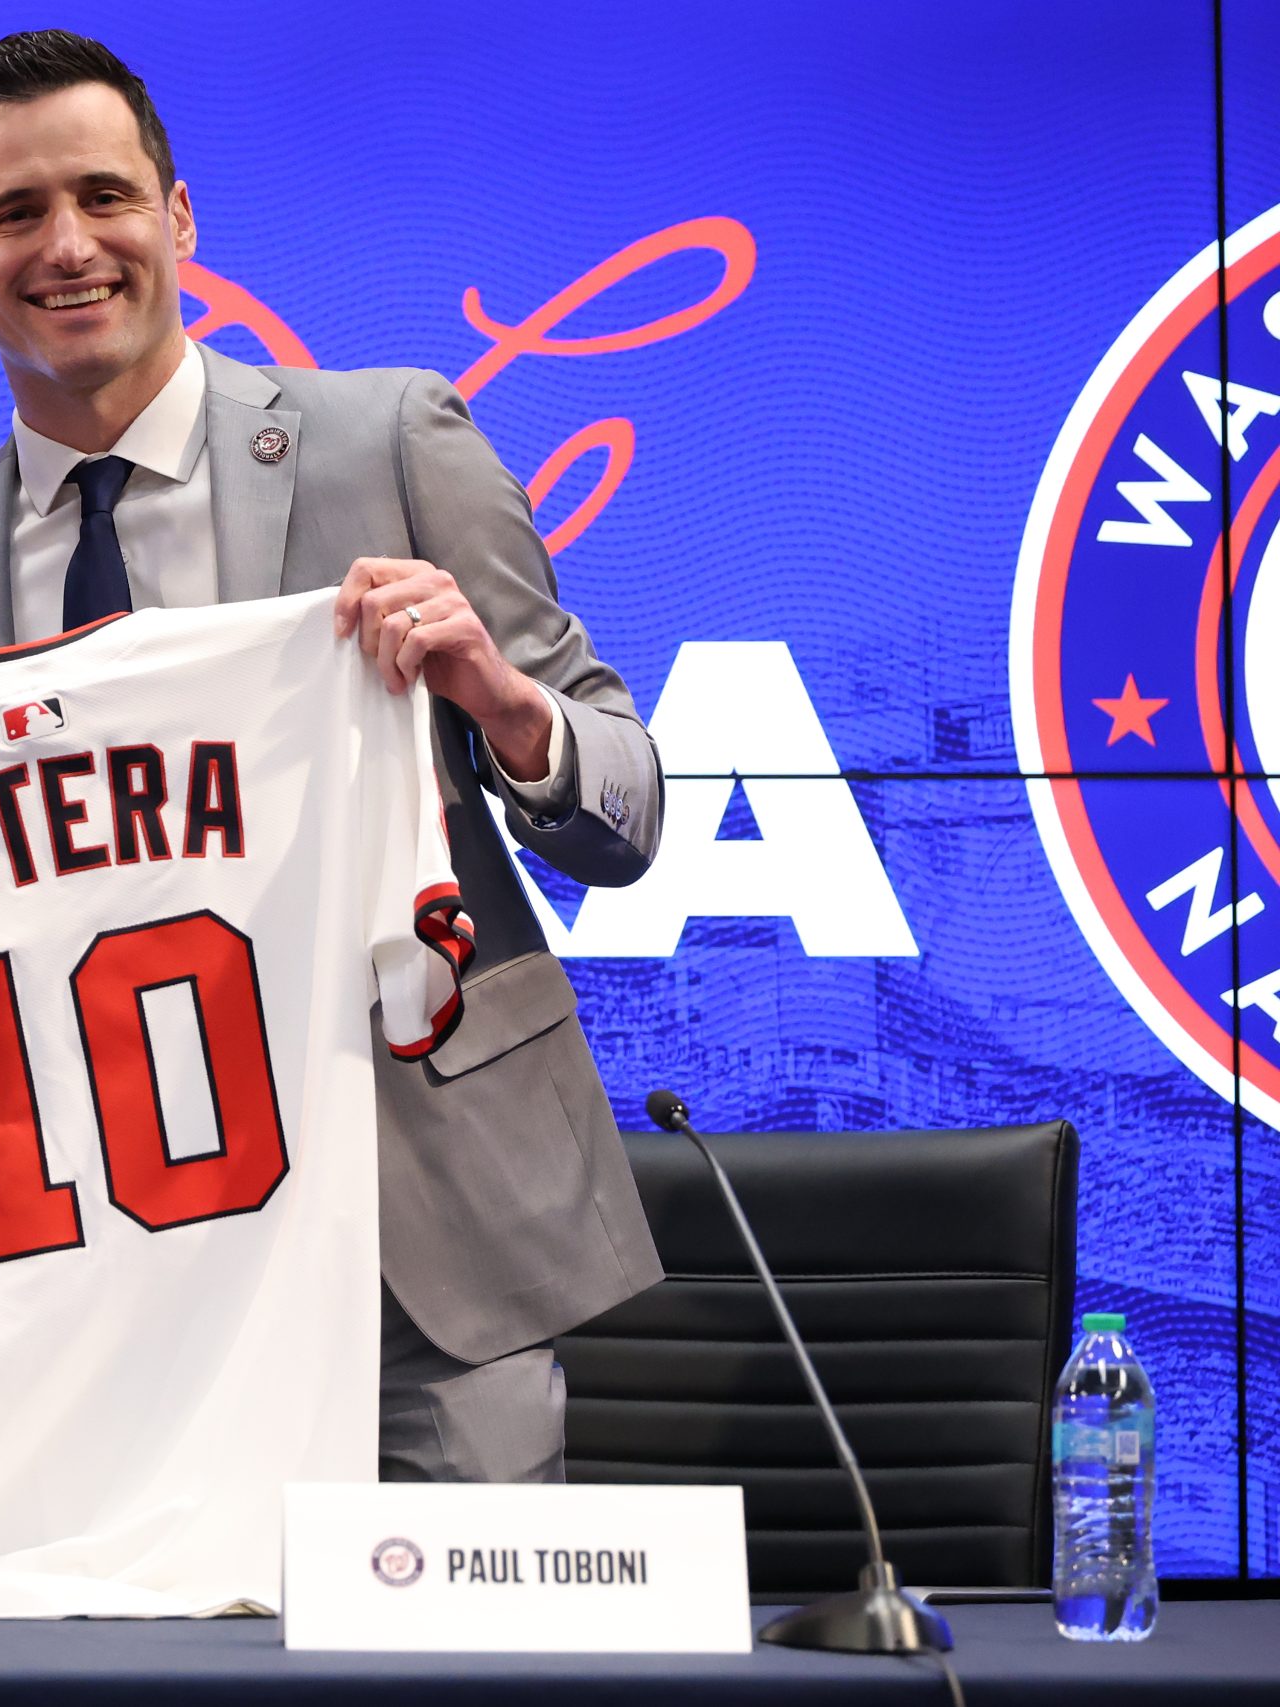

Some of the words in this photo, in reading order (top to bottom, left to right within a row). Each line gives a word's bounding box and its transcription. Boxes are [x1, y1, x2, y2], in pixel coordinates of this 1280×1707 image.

[1096, 290, 1280, 548] WA
[448, 1548, 523, 1583] PAUL
[535, 1549, 647, 1584] TOBONI
